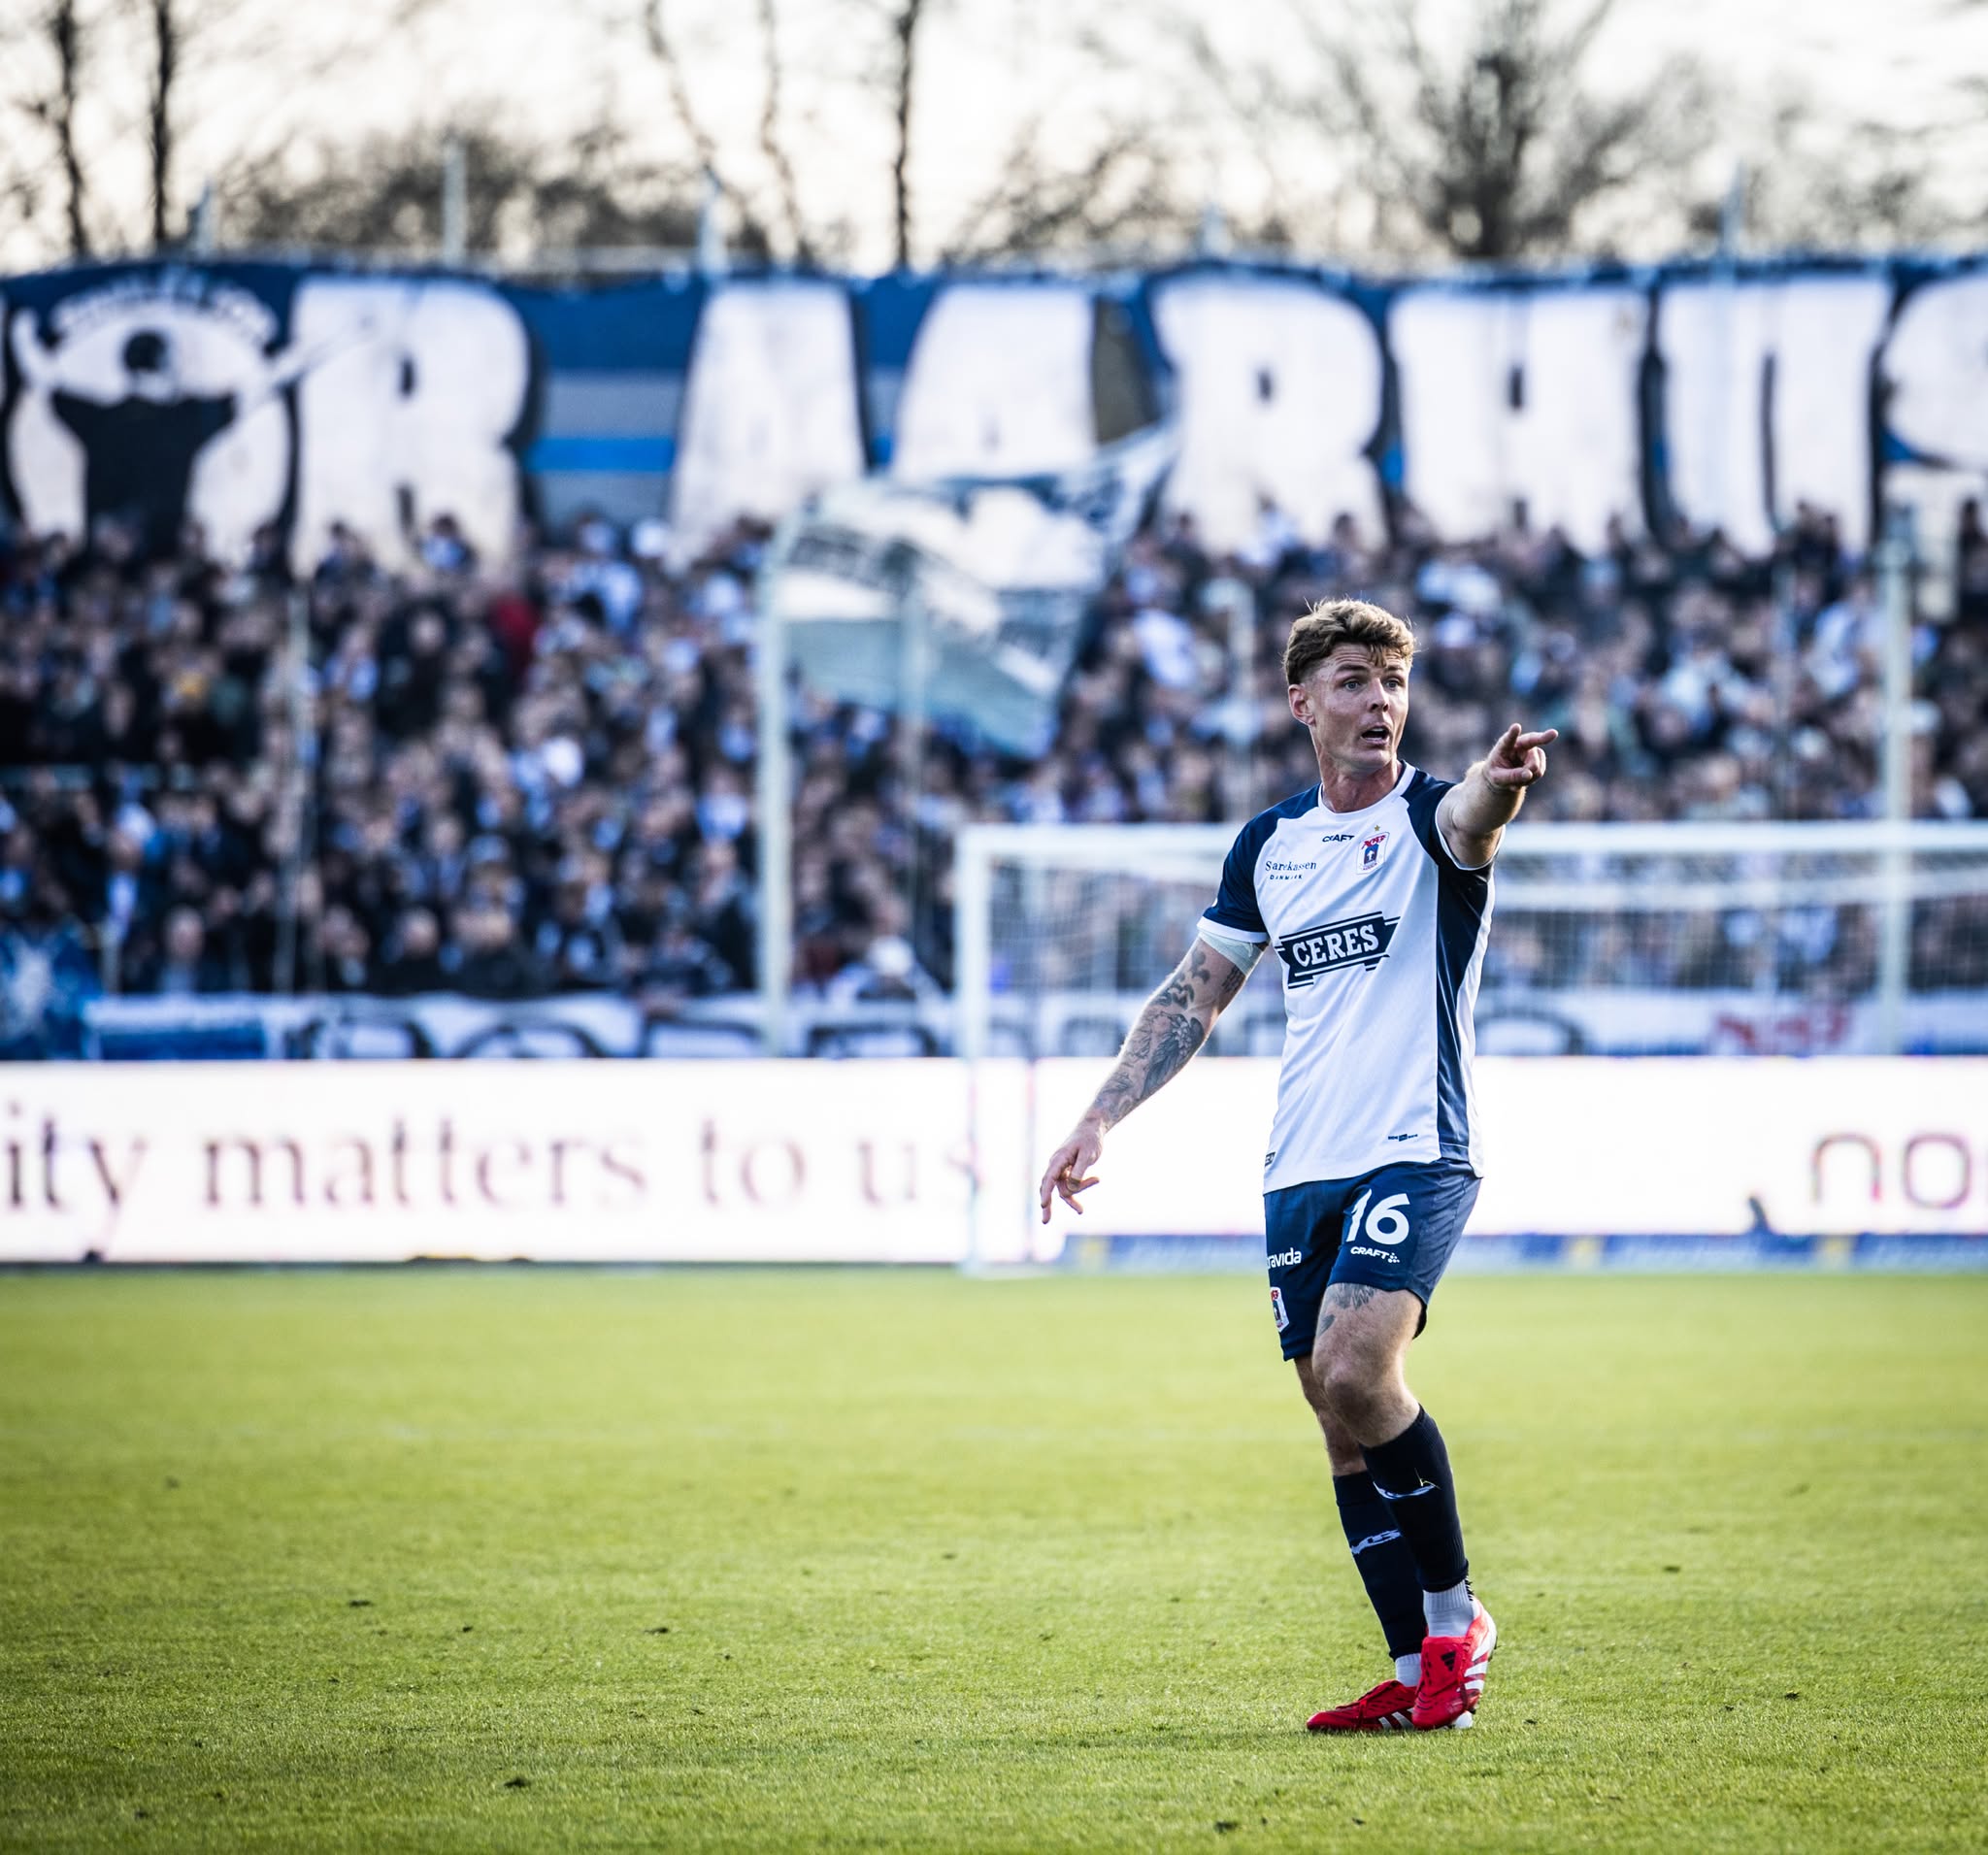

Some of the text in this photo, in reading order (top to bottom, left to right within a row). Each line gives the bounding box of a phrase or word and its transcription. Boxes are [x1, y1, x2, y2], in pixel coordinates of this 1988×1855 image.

[1292, 924, 1379, 968] CERES
[7, 1098, 149, 1254] ity
[202, 1114, 648, 1209] matters
[697, 1116, 807, 1209] to
[1809, 1131, 1988, 1209] no
[1346, 1189, 1410, 1245] 16
[1266, 1247, 1302, 1270] ravida
[1350, 1246, 1389, 1259] CRAFT
